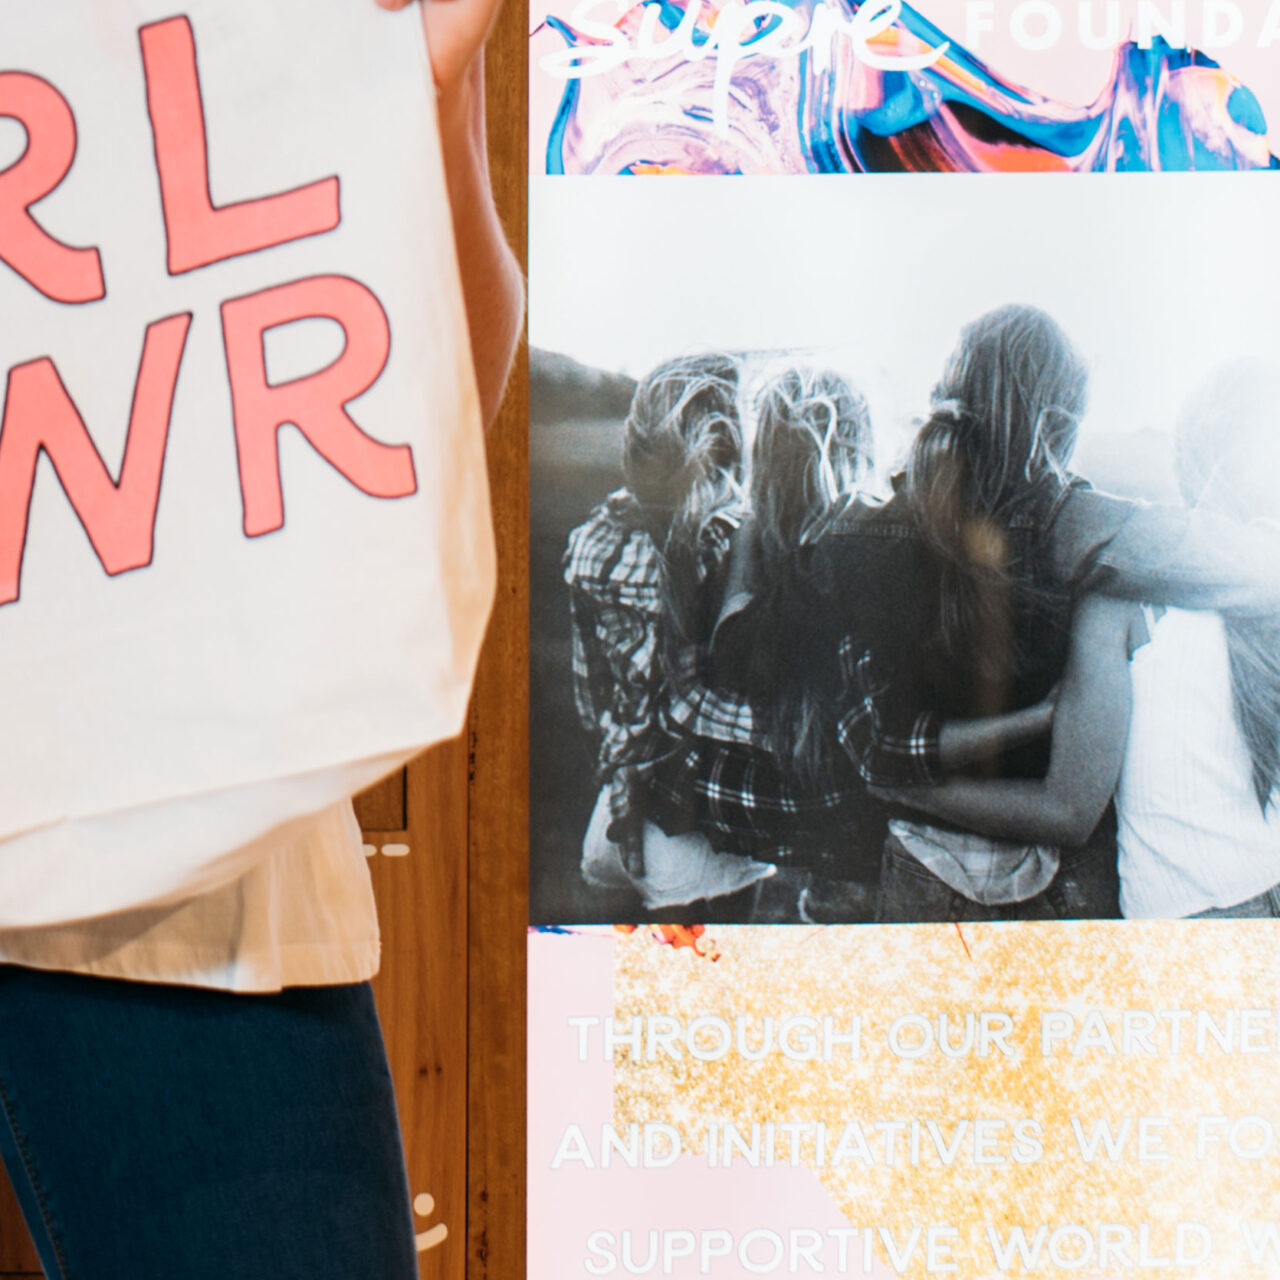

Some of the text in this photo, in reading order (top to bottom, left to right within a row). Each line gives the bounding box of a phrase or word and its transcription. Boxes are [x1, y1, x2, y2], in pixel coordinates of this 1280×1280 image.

[568, 1014, 862, 1062] THROUGH
[886, 1012, 1016, 1058] OUR
[550, 1122, 682, 1170] AND
[708, 1118, 1044, 1168] INITIATIVES
[1070, 1116, 1170, 1162] WE
[584, 1226, 958, 1276] SUPPORTIVE
[985, 1222, 1212, 1271] WORLD
